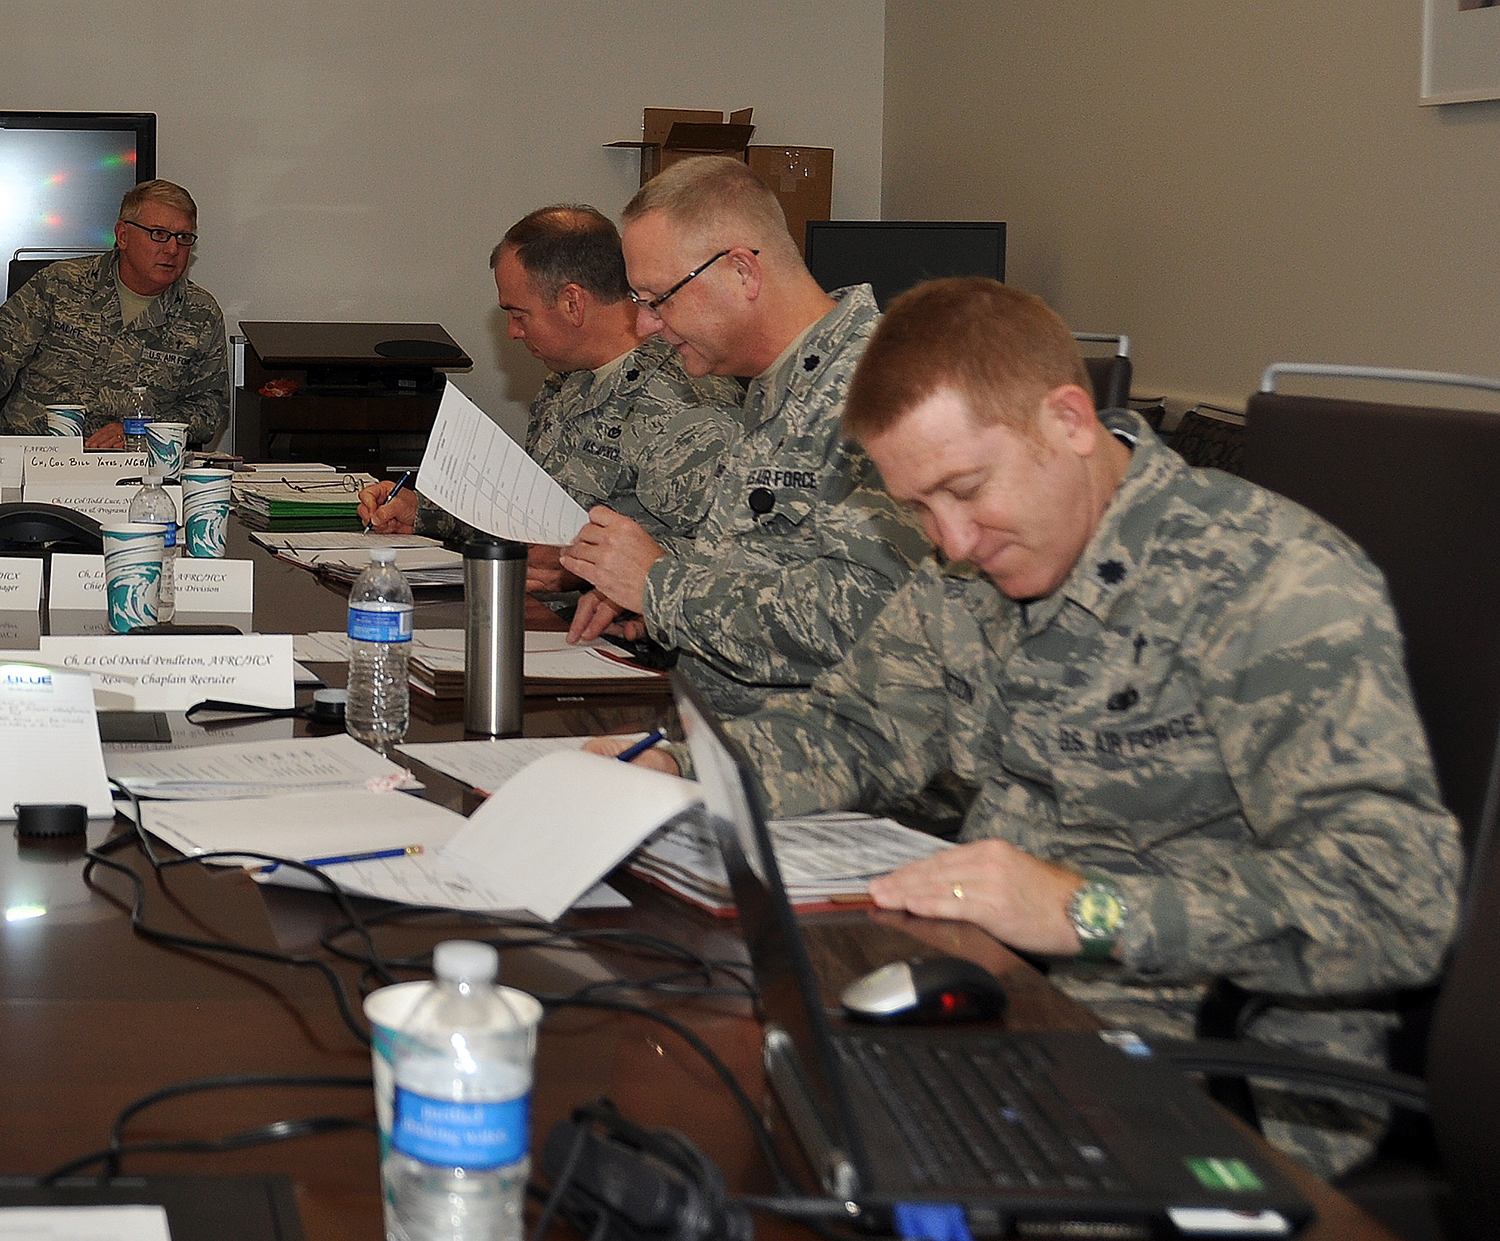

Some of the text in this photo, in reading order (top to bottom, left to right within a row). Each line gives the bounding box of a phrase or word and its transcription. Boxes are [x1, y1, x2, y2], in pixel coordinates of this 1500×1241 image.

[54, 321, 84, 338] CALIFF
[148, 350, 163, 361] U.S.
[163, 353, 176, 364] AIR
[774, 471, 818, 491] FORCE
[74, 496, 86, 504] Col
[97, 506, 127, 515] Programs
[94, 571, 104, 579] Lt
[177, 572, 228, 582] AFRC/HCX
[184, 585, 220, 593] Division
[84, 655, 96, 666] Lt
[99, 654, 118, 666] Col
[118, 655, 150, 666] David
[152, 655, 206, 667] Pendleton,
[207, 655, 273, 667] AFRC/HCX
[141, 672, 186, 687] Chaplain
[189, 674, 237, 685] Recruiter
[1125, 713, 1203, 752] FORCE
